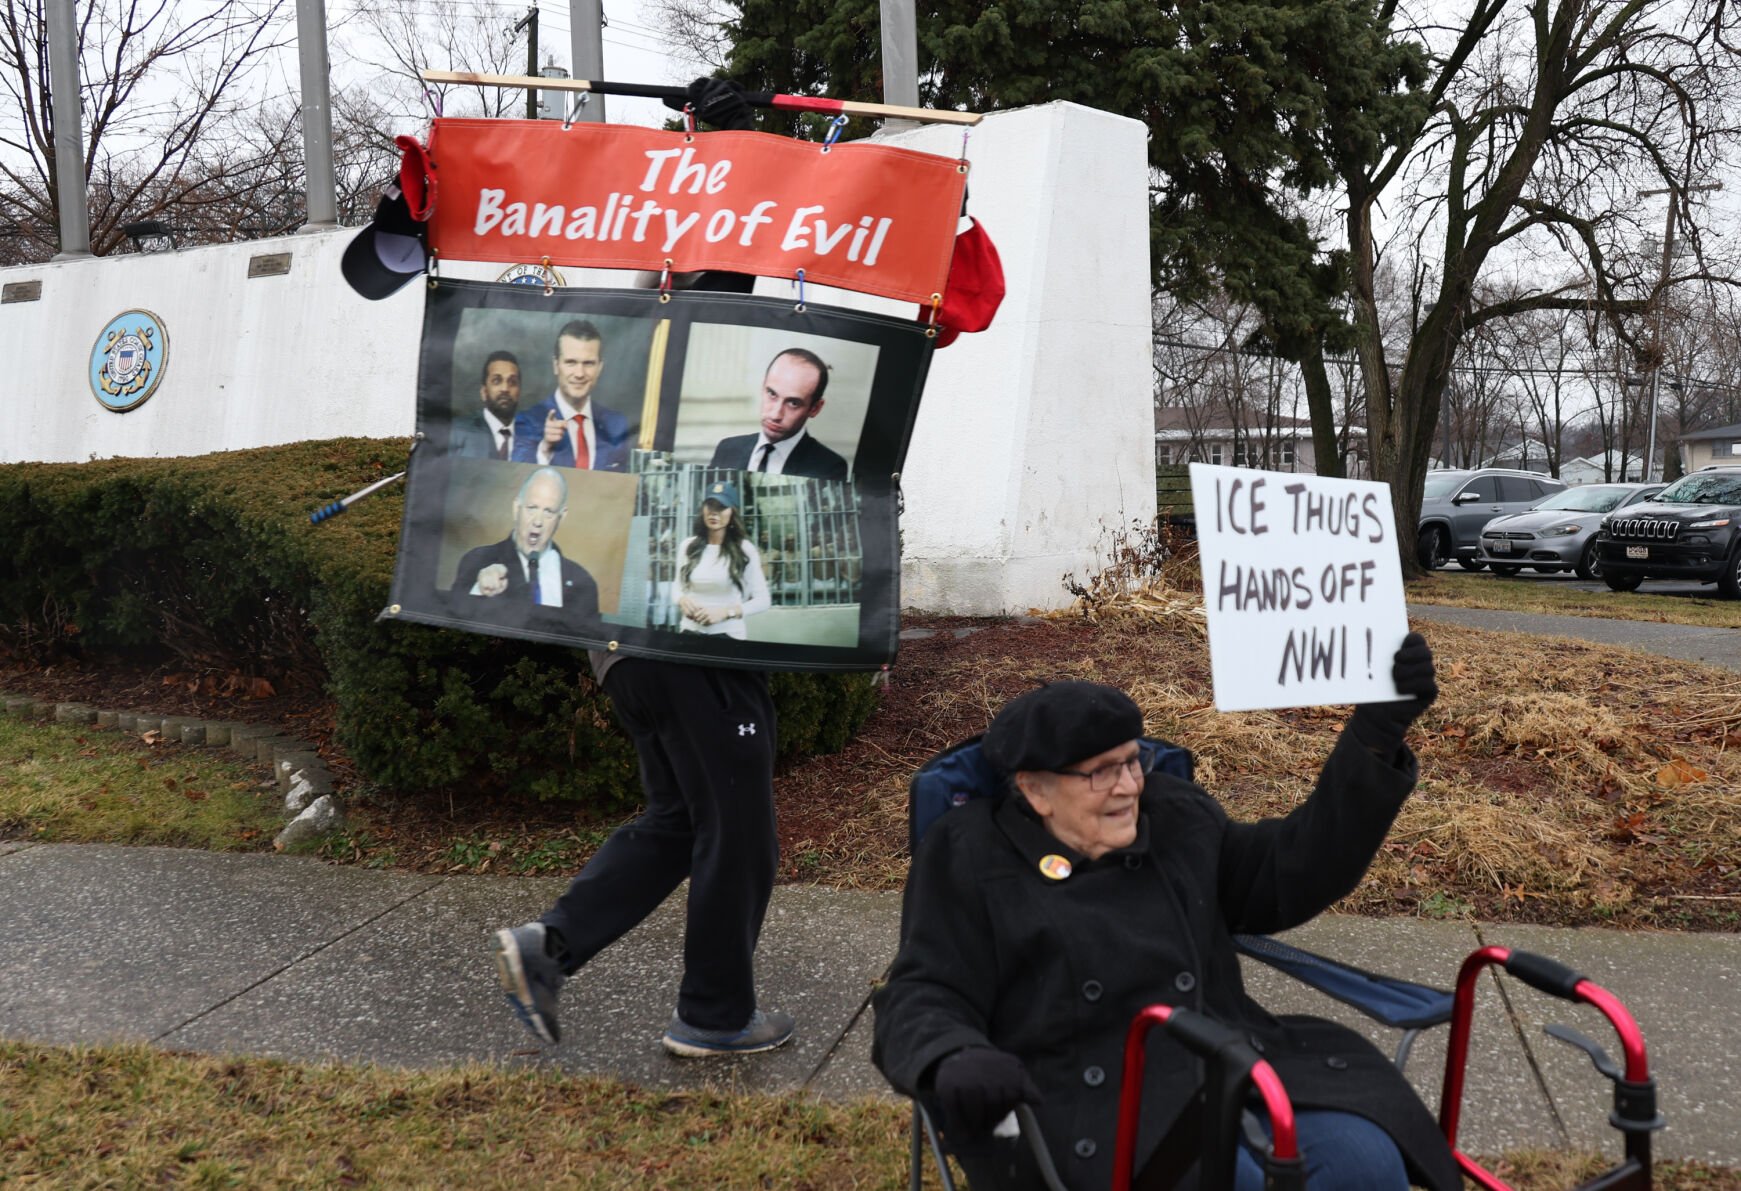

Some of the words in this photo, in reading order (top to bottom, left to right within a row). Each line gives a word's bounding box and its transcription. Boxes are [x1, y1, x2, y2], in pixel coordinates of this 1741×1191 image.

[639, 147, 732, 195] The
[473, 188, 700, 253] Banality
[705, 200, 778, 247] of
[780, 204, 892, 266] Evil
[517, 265, 528, 275] OF
[1216, 477, 1269, 536] ICE
[1284, 482, 1384, 544] THUGS
[1218, 559, 1313, 612] HANDS
[1320, 560, 1376, 604] OFF
